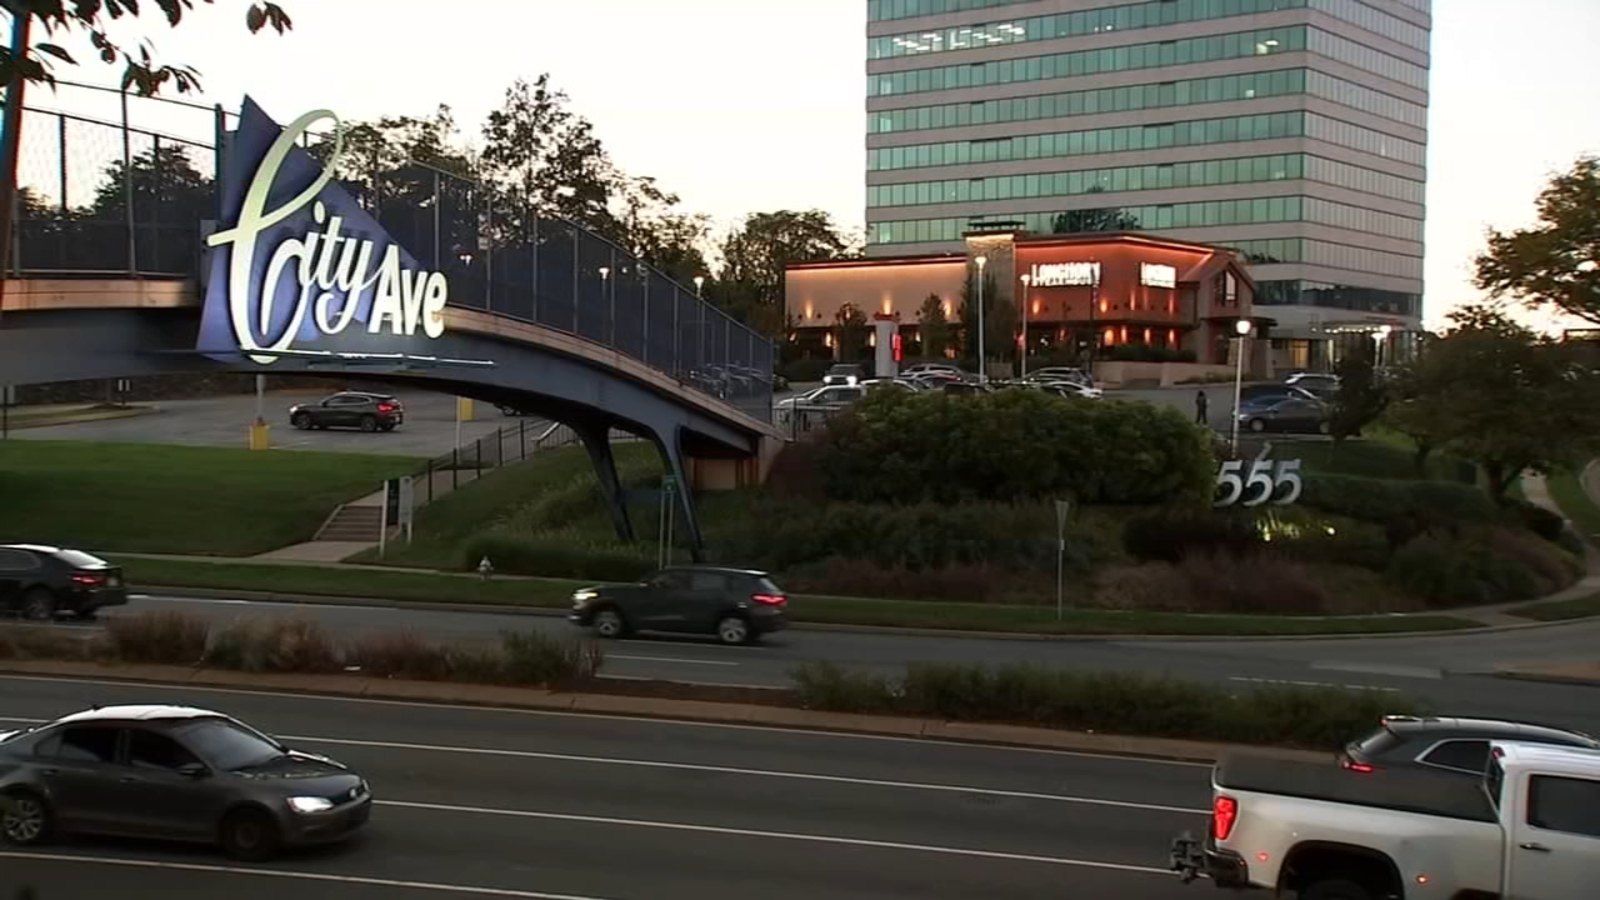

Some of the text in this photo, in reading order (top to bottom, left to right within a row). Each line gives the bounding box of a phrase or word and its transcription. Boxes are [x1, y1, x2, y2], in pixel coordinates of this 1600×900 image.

[207, 109, 448, 364] City Ave
[1213, 459, 1302, 507] 555
